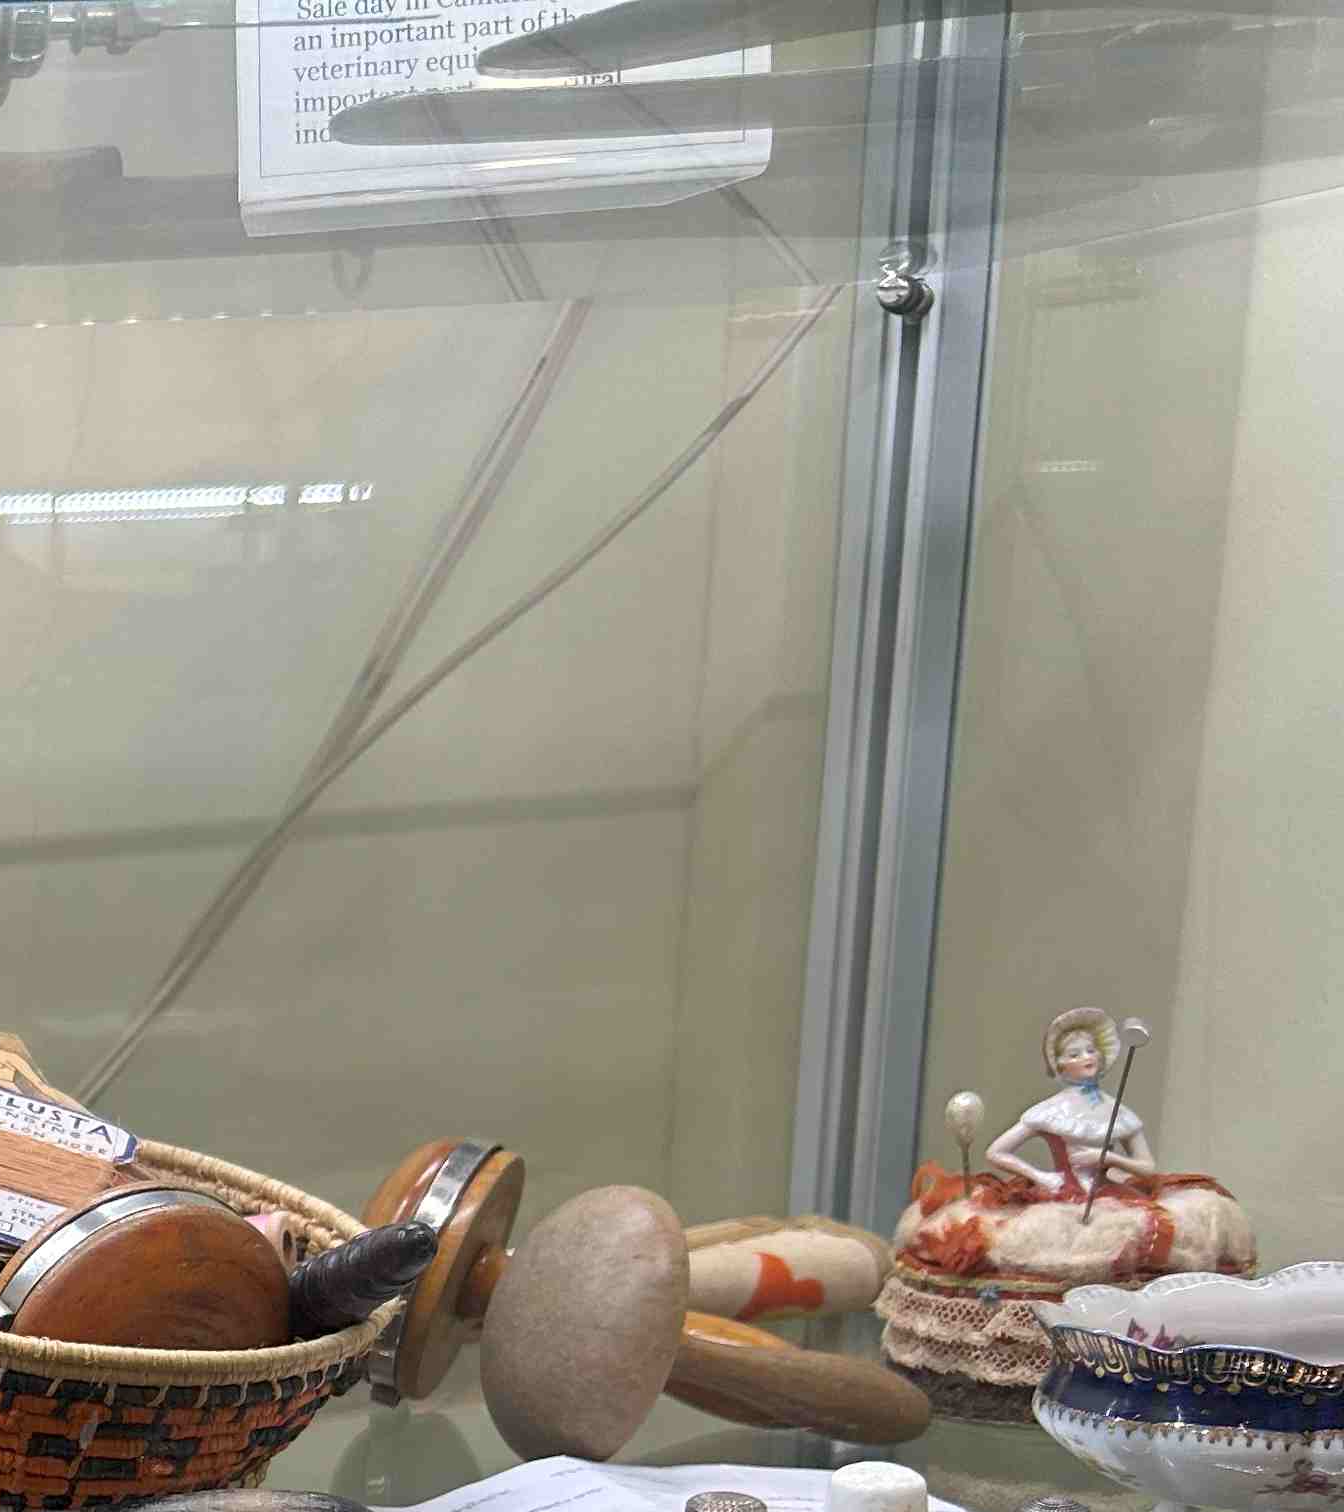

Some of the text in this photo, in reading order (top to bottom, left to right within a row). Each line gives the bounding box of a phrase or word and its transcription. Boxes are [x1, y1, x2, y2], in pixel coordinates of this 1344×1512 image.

[297, 0, 347, 20] Sale
[355, 0, 394, 18] day
[294, 34, 323, 51] an
[331, 22, 456, 54] important
[464, 15, 514, 46] part
[522, 10, 547, 33] of
[294, 56, 418, 82] veterinary
